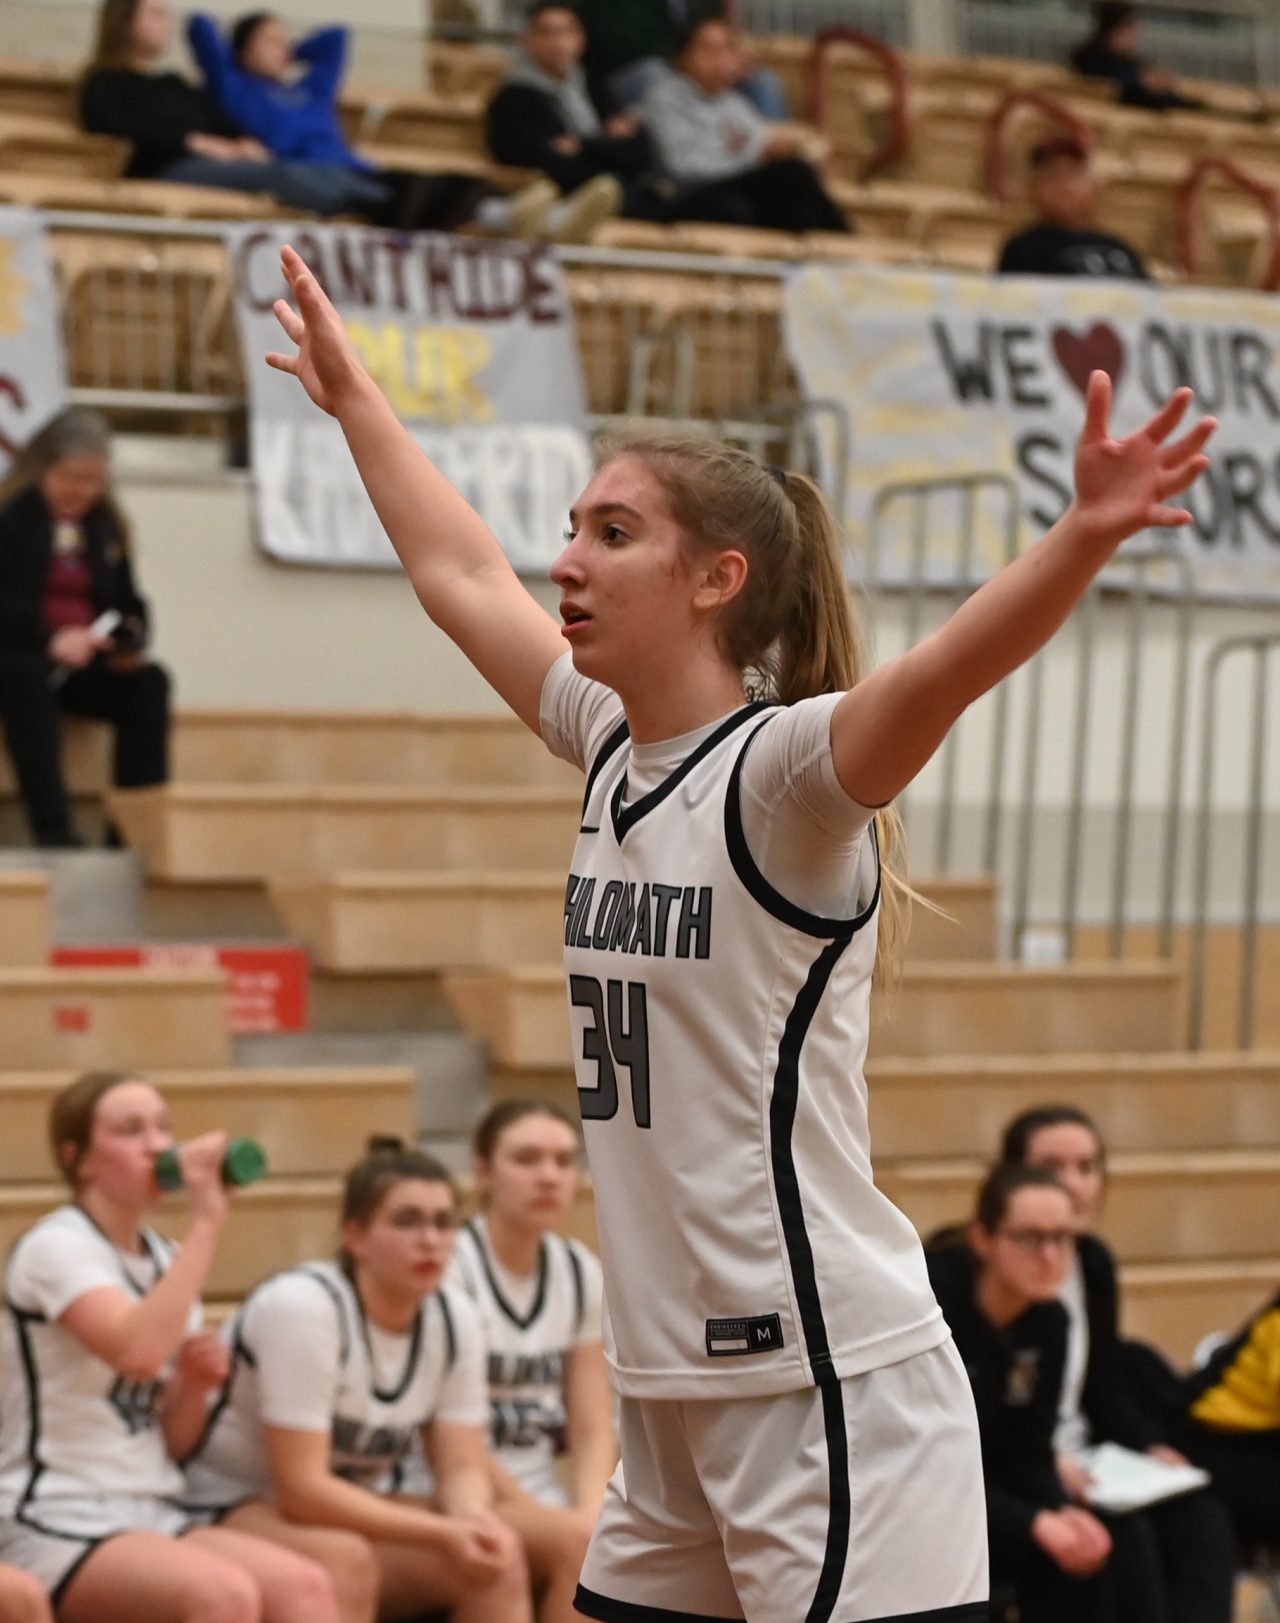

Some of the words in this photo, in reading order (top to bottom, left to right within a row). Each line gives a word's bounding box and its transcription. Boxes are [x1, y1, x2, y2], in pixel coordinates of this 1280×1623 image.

[932, 317, 1049, 409] WE
[1140, 320, 1280, 420] OUR
[569, 974, 651, 1129] 34
[756, 1326, 771, 1342] M
